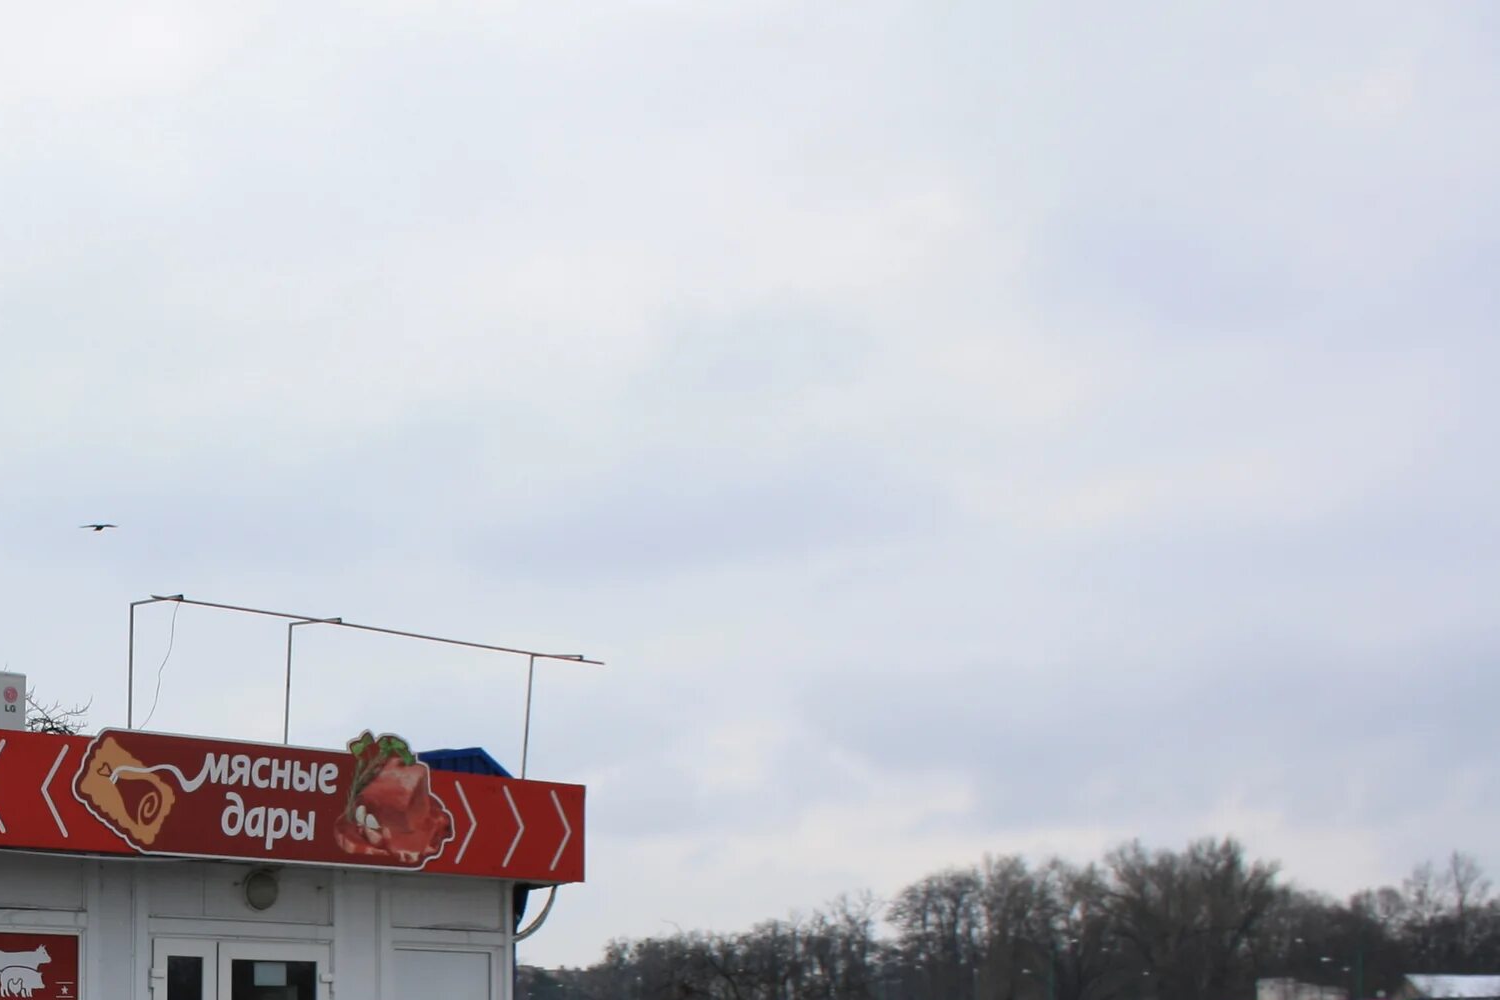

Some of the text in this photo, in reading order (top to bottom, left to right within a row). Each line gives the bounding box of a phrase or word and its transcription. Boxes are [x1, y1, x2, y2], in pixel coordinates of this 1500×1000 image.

[4, 704, 16, 713] LG
[200, 752, 339, 794] мясные
[221, 791, 316, 850] дары
